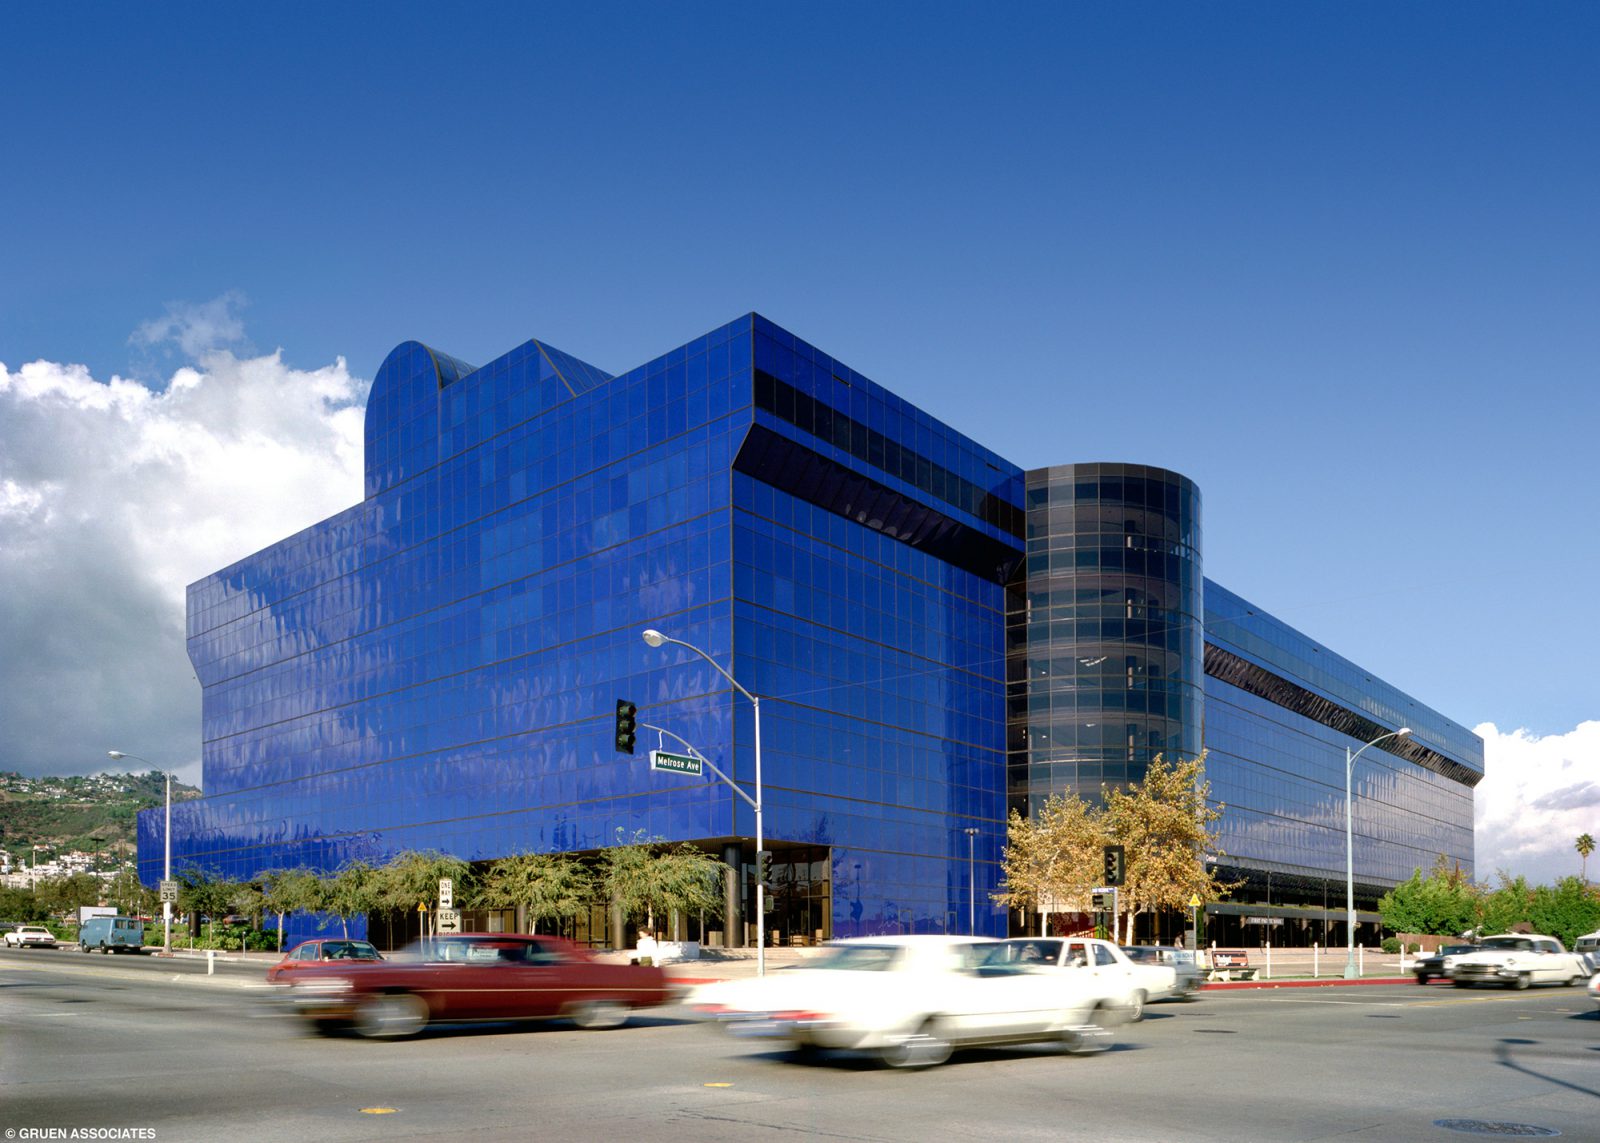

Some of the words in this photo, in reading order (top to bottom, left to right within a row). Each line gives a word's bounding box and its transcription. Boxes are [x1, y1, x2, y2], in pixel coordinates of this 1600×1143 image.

[657, 756, 685, 769] Melrose
[686, 760, 700, 771] Ave
[441, 881, 451, 889] ONE
[162, 892, 176, 900] 35
[439, 912, 459, 920] KEEP
